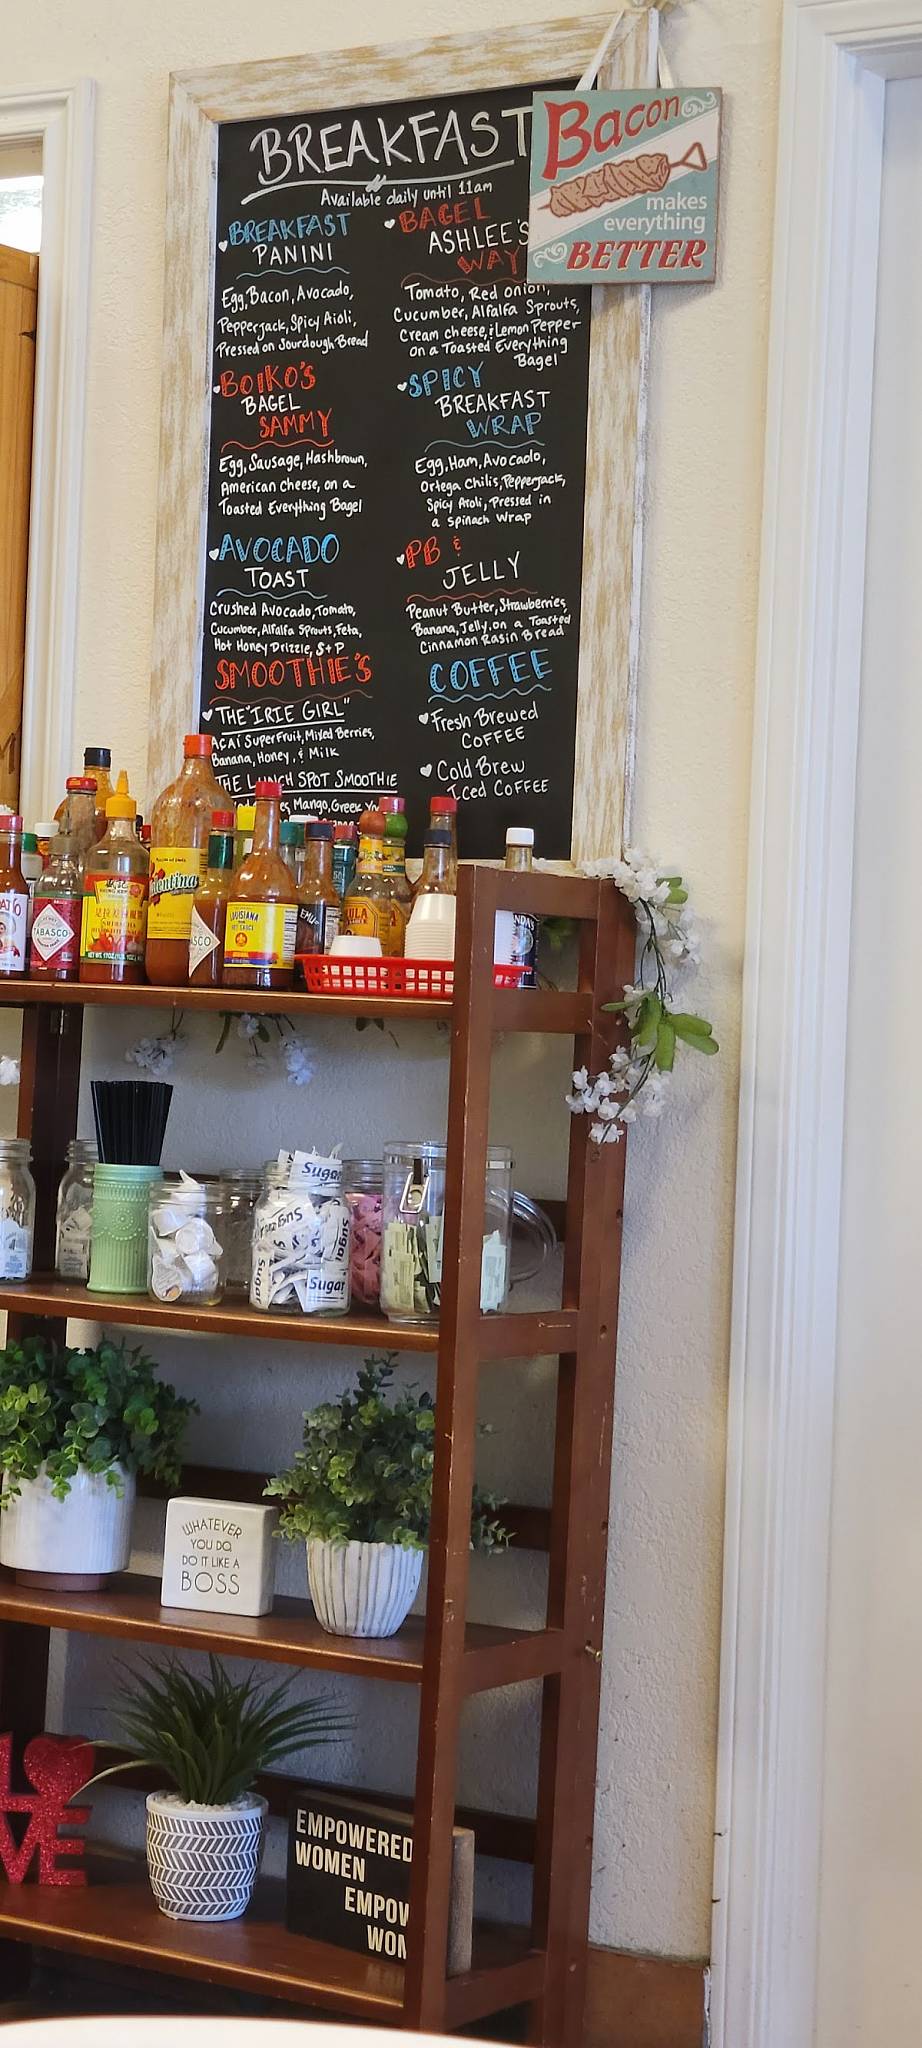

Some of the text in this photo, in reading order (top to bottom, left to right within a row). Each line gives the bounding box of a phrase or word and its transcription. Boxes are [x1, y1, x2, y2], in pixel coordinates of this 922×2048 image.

[249, 107, 533, 184] BREAKFAST
[541, 95, 681, 180] Bacon
[320, 180, 493, 208] Available daily until 11am
[646, 192, 707, 210] makes
[399, 197, 490, 233] BAGEL
[604, 212, 706, 234] everything
[228, 212, 351, 246] BREAKFAST
[428, 220, 530, 255] ASHLEE'S
[252, 242, 333, 266] PANINI
[456, 246, 520, 275] WAY
[566, 239, 706, 270] BETTER
[297, 280, 354, 302] Avocado,
[404, 282, 550, 302] Tomato, Red onion,
[324, 309, 357, 327] Aioli,
[394, 298, 580, 322] Cucumber, Alfalfa Sprouts,
[444, 321, 488, 340] cheese,
[495, 322, 529, 338] Lemon
[530, 318, 582, 335] Pepper
[215, 330, 369, 358] Pressed on Sourdough Bread
[410, 336, 568, 357] on a Toasted Everything
[514, 354, 558, 371] Bagel
[220, 361, 316, 397] BOIKO'S
[408, 361, 484, 398] SPICY
[241, 393, 300, 416] BAGEL
[434, 390, 550, 417] BREAKFAST
[259, 408, 332, 438] SAMMY
[466, 412, 542, 438] WRAP
[306, 449, 368, 468] Hashbrown,
[221, 480, 276, 496] American
[324, 480, 338, 490] on
[342, 478, 356, 488] a
[420, 478, 461, 496] Ortega
[464, 474, 502, 491] Chilis,
[218, 497, 362, 520] Toasted Everything Bagel
[427, 498, 453, 514] Spicy
[489, 494, 532, 509] Pressed
[539, 494, 551, 504] in
[432, 518, 440, 528] a
[219, 533, 340, 564] AVOCADO
[405, 536, 440, 568] PB
[244, 567, 309, 589] TOAST
[442, 551, 520, 590] JELLY
[210, 601, 356, 620] Crushed Avocado, Tomato,
[405, 596, 568, 620] Peanut Butter, Strawberries,
[210, 622, 362, 638] Cucumber, Alfalfa Sprouts, Feta,
[411, 622, 459, 637] Banana,
[514, 620, 523, 628] a
[529, 614, 571, 626] Toasted
[214, 638, 232, 652] Hot
[236, 639, 268, 656] Honey
[270, 642, 312, 657] Drizzle,
[420, 626, 564, 654] Cinnamon Rasin Bread
[214, 652, 372, 690] SMOOTHIE'S
[429, 649, 552, 692] COFFEE
[215, 706, 246, 726] THE
[431, 701, 538, 732] Fresh Brewed
[304, 729, 333, 742] Mixed
[334, 726, 375, 740] Berries,
[212, 753, 256, 768] Banana,
[309, 748, 340, 760] Milk
[437, 755, 525, 781] Cold Brew
[215, 775, 242, 792] THE
[298, 772, 330, 788] SPOT
[447, 781, 486, 800] Iced
[294, 797, 331, 814] Mango,
[34, 928, 68, 938] TABASCO
[309, 1277, 345, 1295] Sugar
[182, 1518, 242, 1539] WHATEVER
[190, 1539, 212, 1550] YOU
[182, 1555, 240, 1568] DO IT LIKE A
[182, 1571, 240, 1595] BOSS
[296, 1808, 413, 1863] EMPOWERED
[295, 1840, 365, 1882] WOMEN
